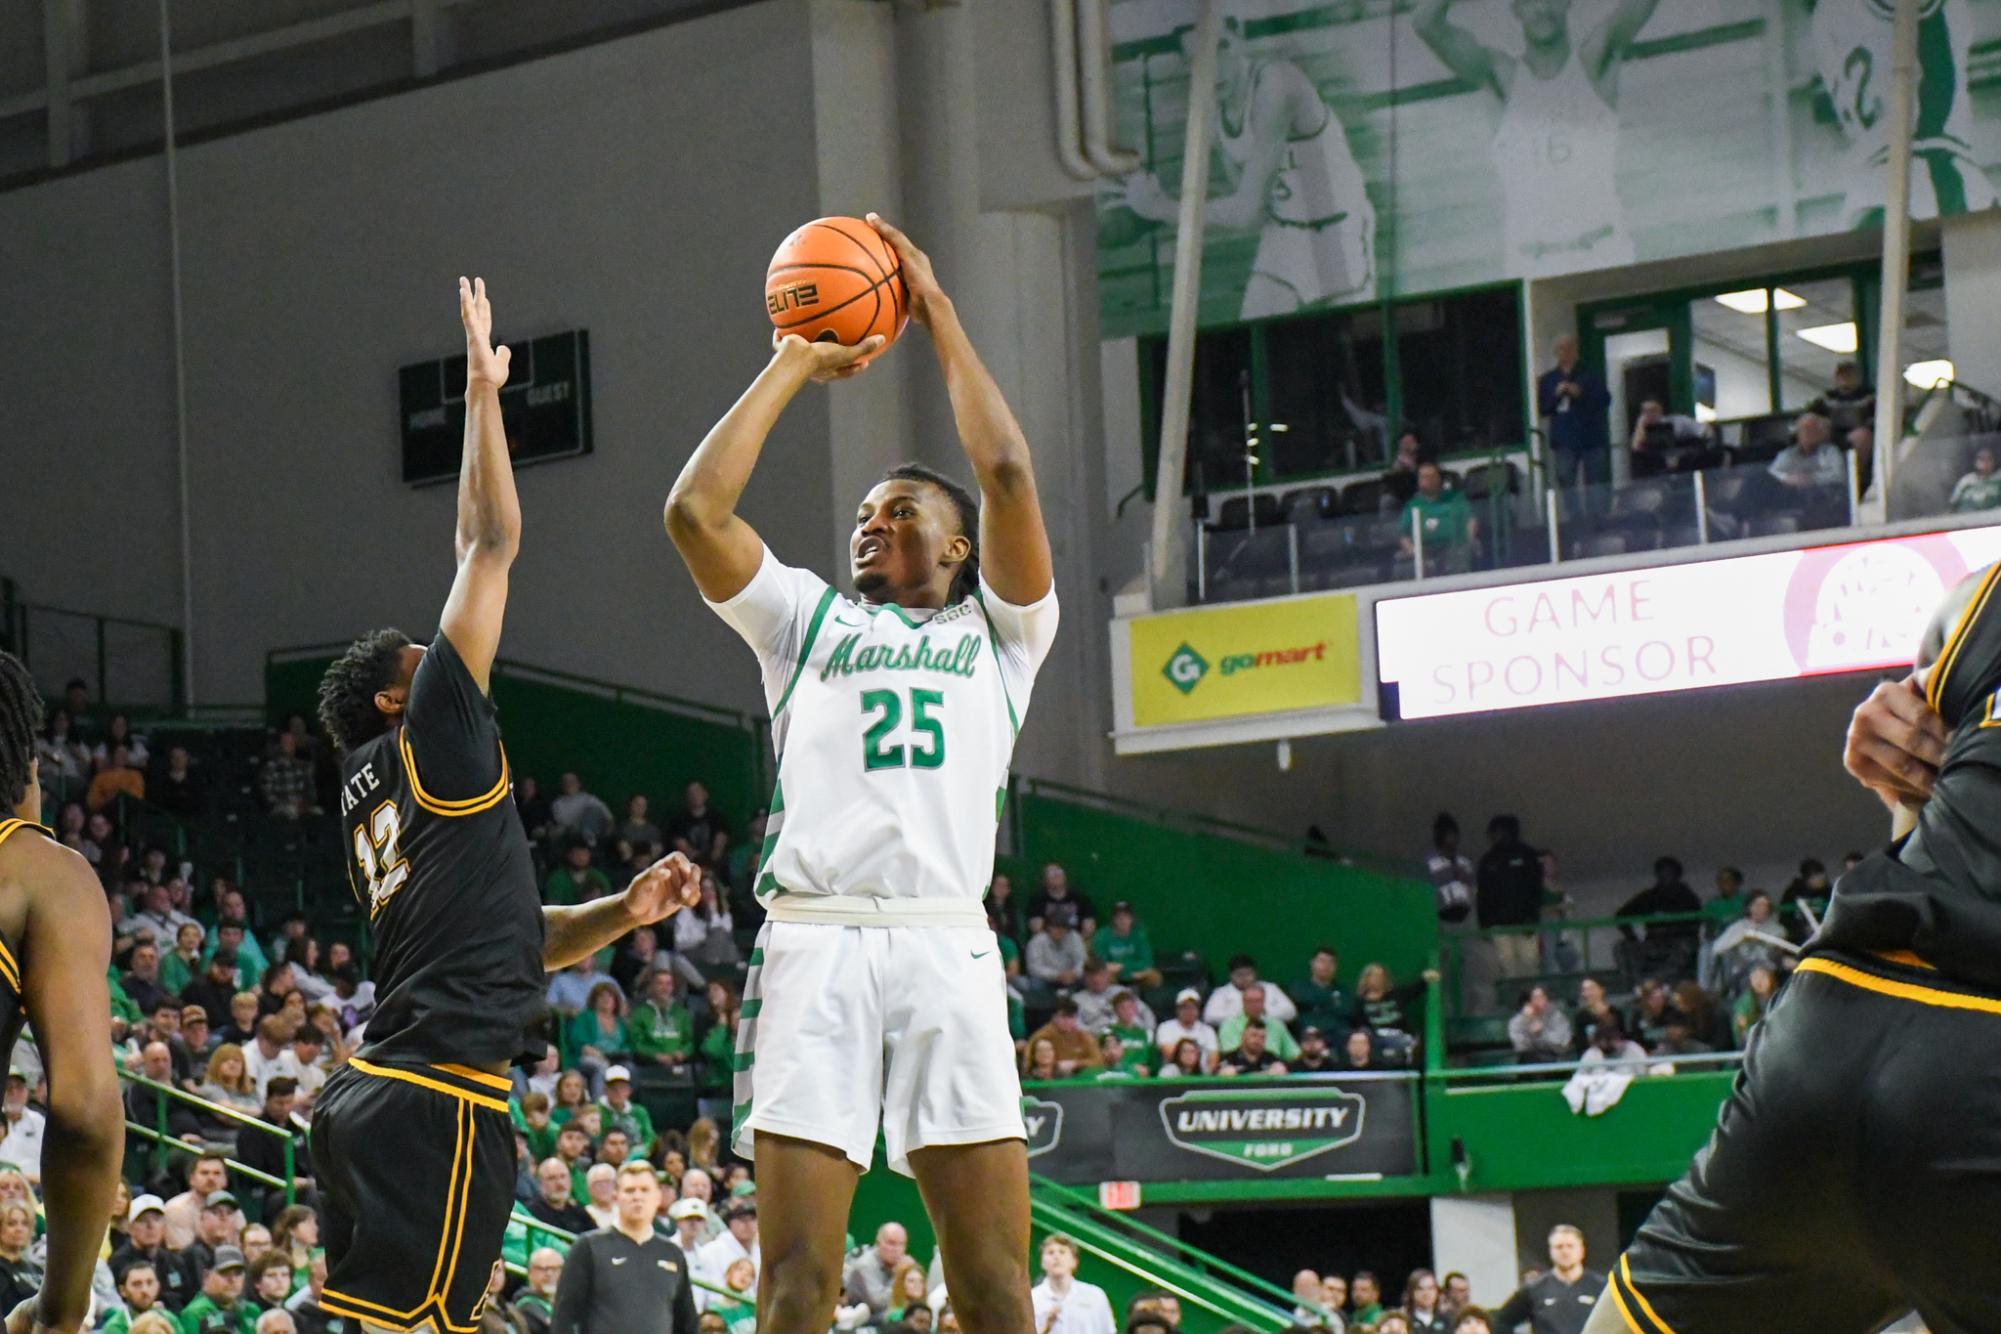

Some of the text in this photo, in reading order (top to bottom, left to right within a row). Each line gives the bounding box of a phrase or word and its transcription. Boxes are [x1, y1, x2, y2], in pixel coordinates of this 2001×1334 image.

[767, 284, 819, 315] ELITE
[1484, 579, 1654, 637] GAME
[820, 633, 981, 682] Marshall
[1220, 640, 1327, 676] gomart
[1432, 635, 1717, 705] SPONSOR
[859, 687, 945, 772] 25
[353, 798, 411, 921] 12
[1177, 1106, 1349, 1132] UNIVERSITY
